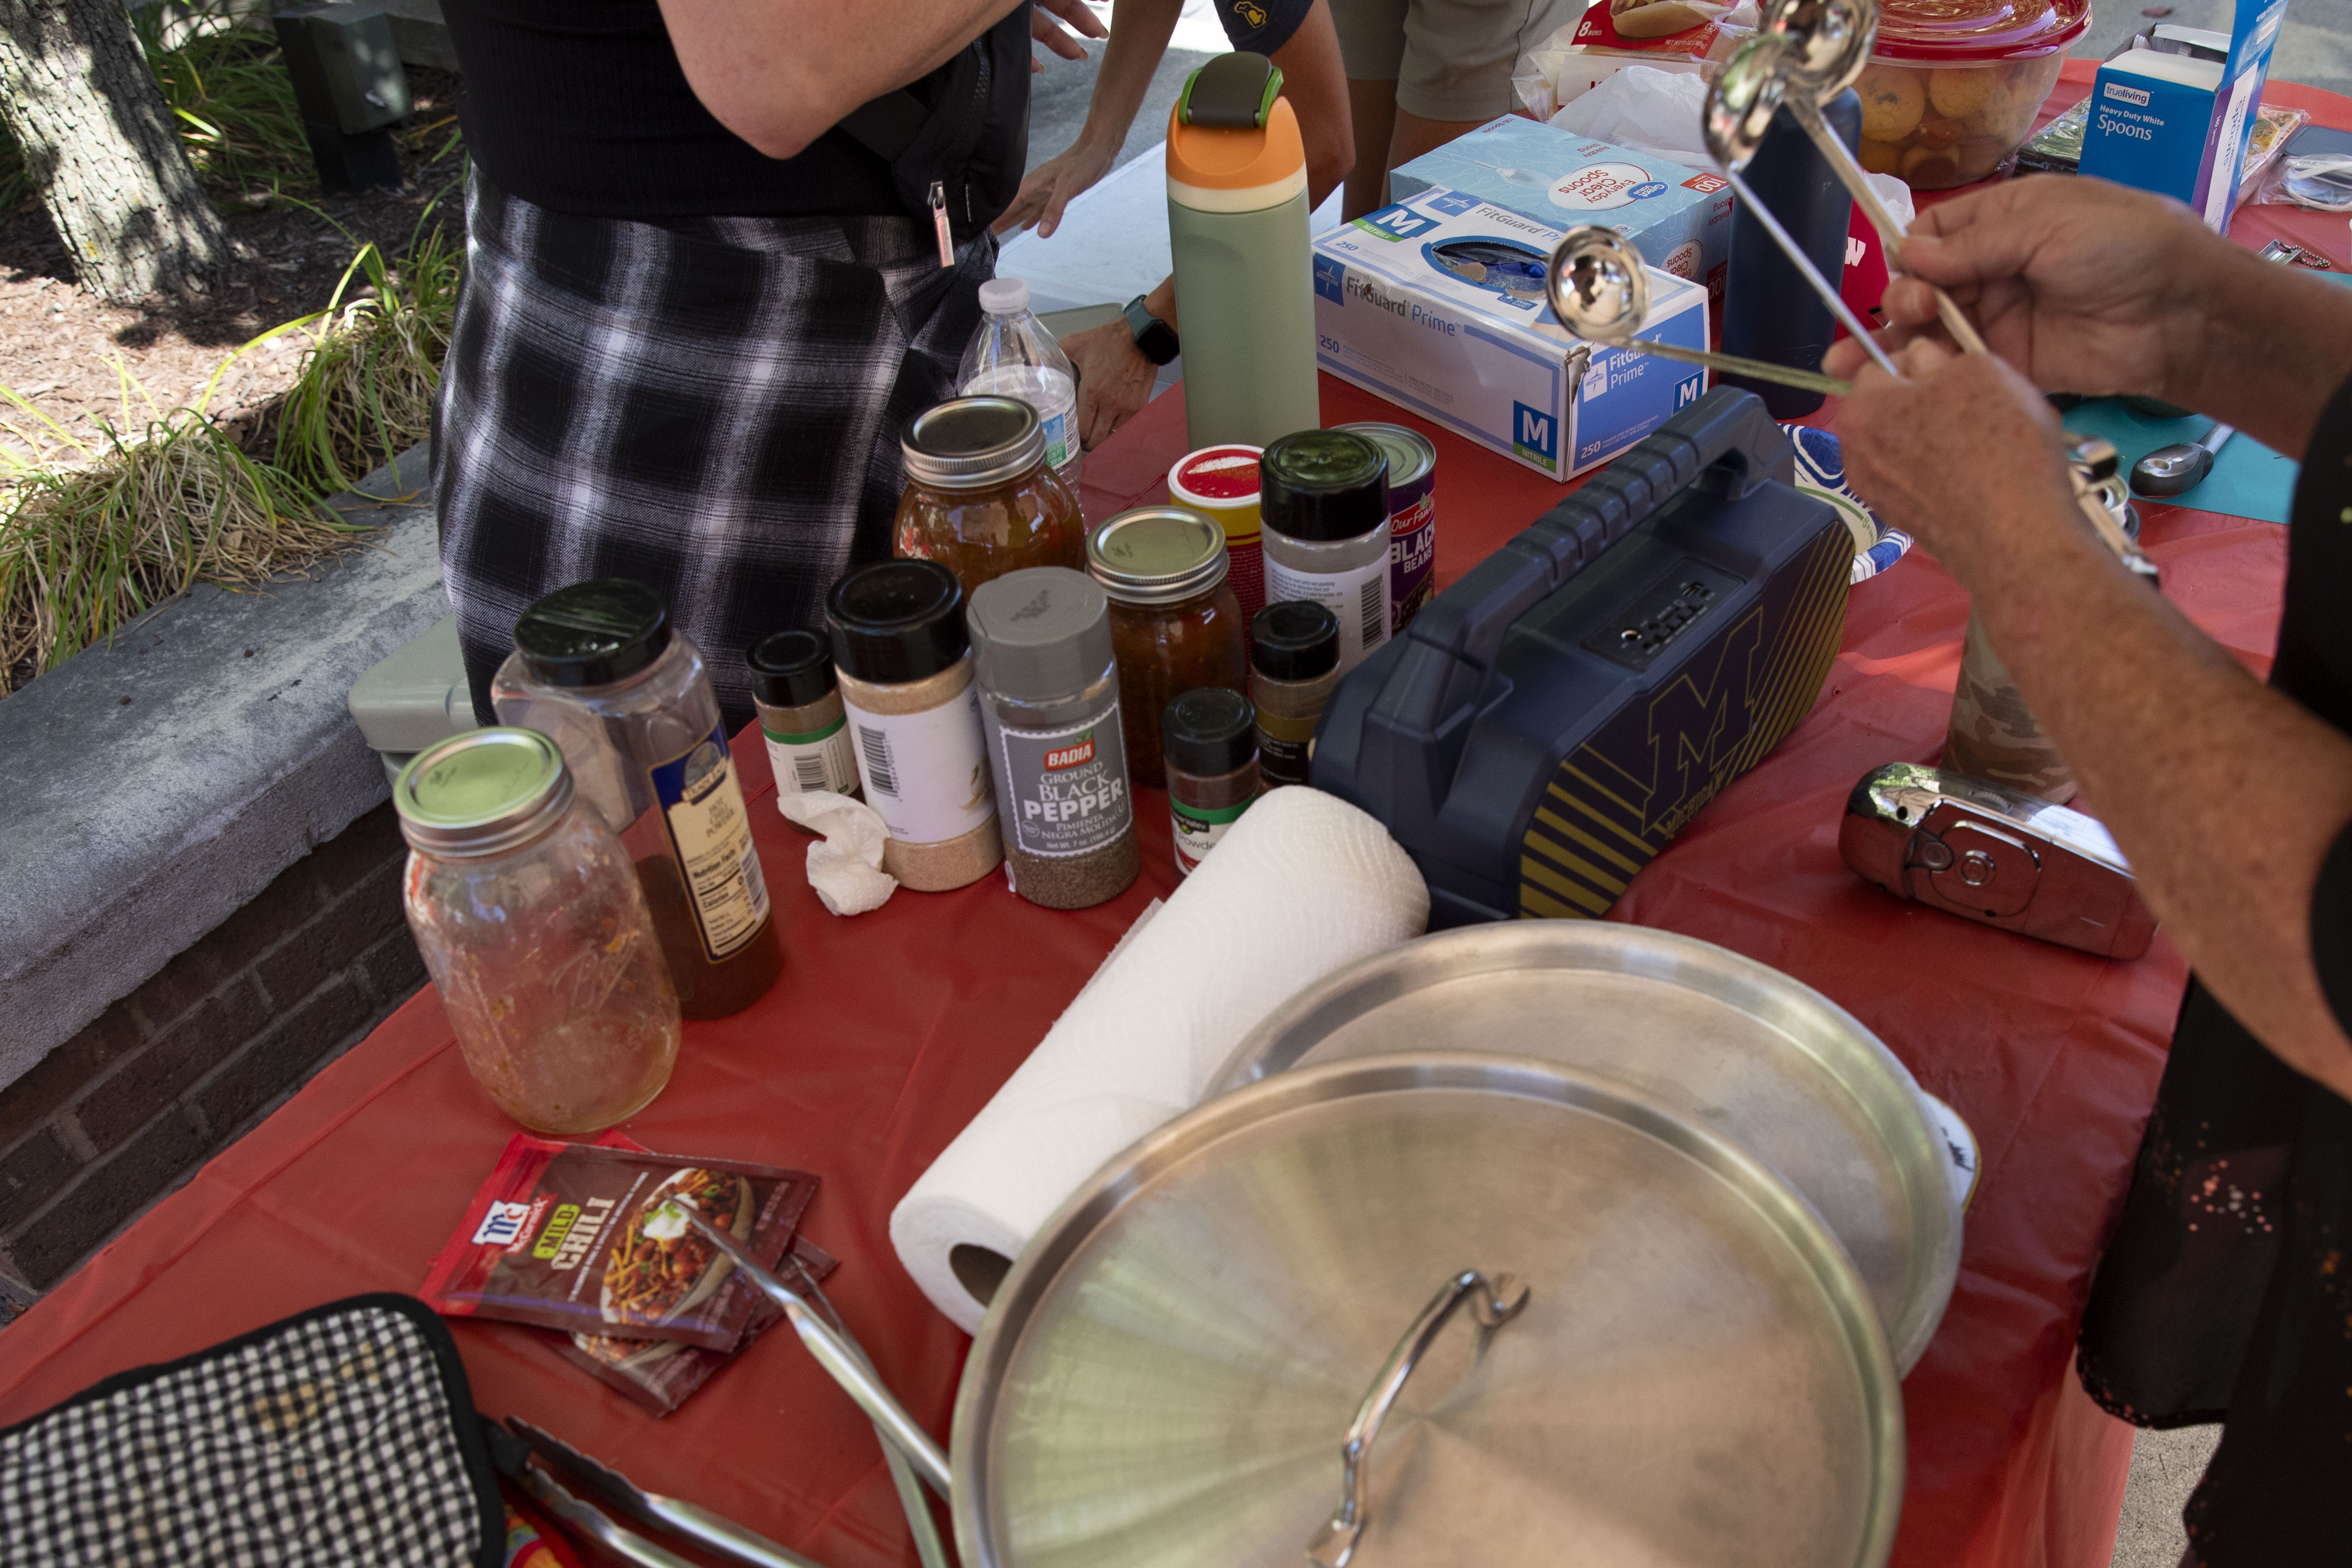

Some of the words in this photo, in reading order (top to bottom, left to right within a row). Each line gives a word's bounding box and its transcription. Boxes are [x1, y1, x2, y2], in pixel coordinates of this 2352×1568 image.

[1578, 21, 1592, 37] 8
[2107, 86, 2147, 104] trueliving
[2100, 105, 2123, 117] Heavy
[2123, 111, 2141, 122] Duty
[2143, 115, 2164, 126] White
[2097, 114, 2153, 140] Spoons
[2223, 100, 2242, 166] Spoons
[1582, 146, 1610, 158] Reliably
[1558, 170, 1609, 193] Spoons
[1578, 178, 1617, 196] Clear
[1586, 179, 1636, 203] Everyday
[1633, 186, 1653, 195] Value
[1638, 184, 1665, 197] Great
[1695, 178, 1728, 192] 100
[1441, 197, 1470, 209] MEDLINE
[1376, 209, 1426, 235] M
[1475, 207, 1544, 234] FitGuard
[1708, 209, 1730, 226] Reliably
[1362, 224, 1393, 240] NITRILE
[1335, 241, 1358, 251] 250
[1845, 236, 1866, 267] W
[1667, 248, 1692, 268] Spoons
[1316, 271, 1339, 287] MEDLINE
[1412, 304, 1455, 337] Prime
[1320, 334, 1340, 354] 250
[1586, 374, 1604, 387] MEDLINE
[1611, 364, 1644, 389] Prime
[1679, 377, 1698, 408] M
[1523, 410, 1549, 452] M
[1522, 448, 1547, 466] NITRILE
[1581, 440, 1601, 459] 250
[1391, 518, 1413, 532] Our
[1404, 546, 1432, 574] BEANS
[1642, 606, 1763, 837] M
[1047, 743, 1092, 767] BADIA
[1040, 761, 1103, 785] GROUND
[1038, 770, 1111, 802] BLACK
[1023, 777, 1123, 823] PEPPER
[1041, 830, 1078, 839] NEGRA
[1080, 815, 1116, 834] MOLIDA
[1057, 814, 1104, 831] PIMIENTA
[1178, 835, 1216, 850] Powde
[693, 861, 721, 878] Nutrition
[721, 849, 736, 861] Facts
[703, 892, 728, 908] Calories
[506, 1196, 549, 1253] McCormick
[540, 1210, 576, 1249] MILD
[551, 1196, 616, 1270] CHILI
